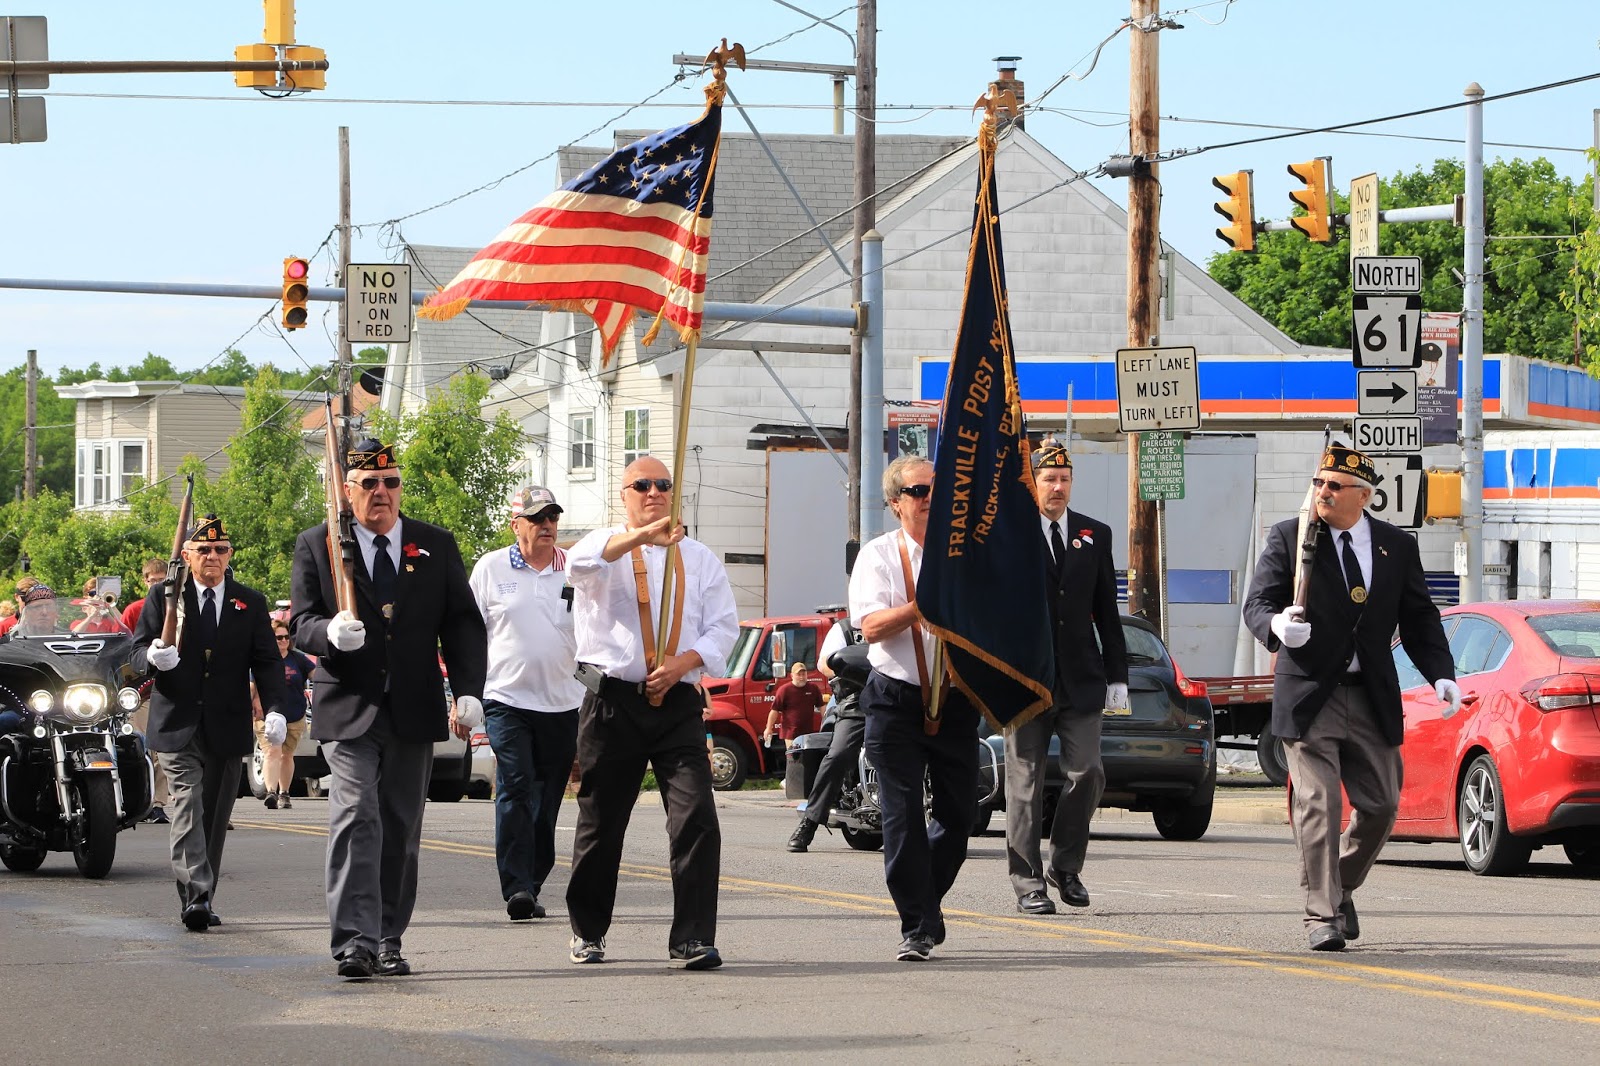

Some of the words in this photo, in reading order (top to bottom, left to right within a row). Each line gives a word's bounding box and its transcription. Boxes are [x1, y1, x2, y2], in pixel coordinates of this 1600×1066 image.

[1357, 184, 1371, 205] NO
[1356, 208, 1371, 225] TURN
[1359, 227, 1369, 242] ON
[1358, 246, 1370, 257] RED
[363, 271, 395, 288] NO
[1358, 263, 1415, 286] NORTH
[360, 292, 397, 304] TURN
[368, 308, 389, 320] ON
[365, 324, 393, 336] RED
[1363, 314, 1407, 352] 61
[1123, 359, 1152, 372] LEFT
[1159, 357, 1190, 371] LANE
[963, 356, 995, 418] POST
[1136, 381, 1179, 397] MUST
[1125, 407, 1156, 421] TURN
[1164, 406, 1194, 420] LEFT
[1149, 432, 1172, 440] SNOW
[1359, 424, 1418, 446] SOUTH
[1141, 439, 1181, 447] EMERGENCY
[1153, 469, 1182, 477] PARKING
[948, 425, 980, 557] FRACKVILLE
[1143, 484, 1181, 492] VEHICLES
